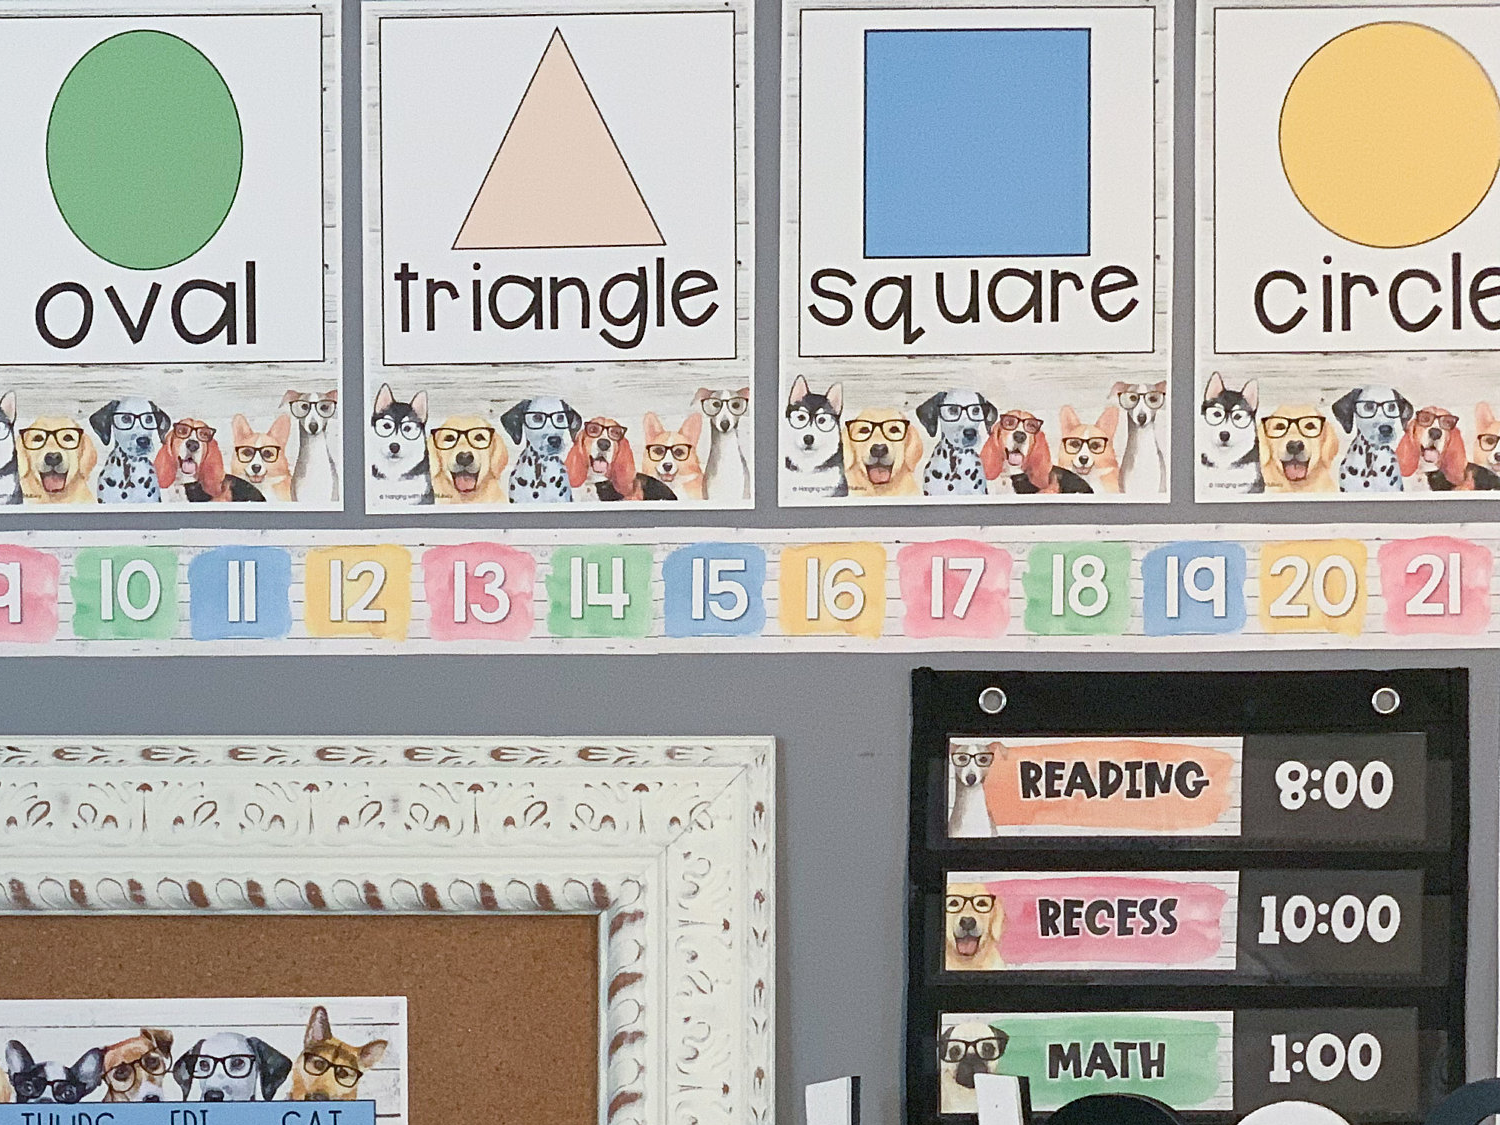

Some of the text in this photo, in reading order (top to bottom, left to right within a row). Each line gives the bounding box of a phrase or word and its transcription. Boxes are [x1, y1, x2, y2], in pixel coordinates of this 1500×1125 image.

[35, 261, 257, 348] oval
[394, 257, 719, 349] triangle
[807, 265, 1140, 345] square
[101, 558, 161, 621] 10
[229, 560, 256, 623] 11
[329, 558, 386, 622] 12
[453, 560, 510, 624] 13
[570, 557, 630, 620] 14
[691, 558, 749, 621] 15
[804, 558, 865, 620] 16
[931, 556, 987, 619] 17
[1051, 553, 1109, 616] 18
[1166, 555, 1226, 618] 19
[1269, 555, 1358, 618] 20
[1405, 553, 1462, 616] 21
[1019, 759, 1394, 811] READING 8:00
[1038, 894, 1401, 945] RECESS 10:00
[1047, 1032, 1382, 1083] MATH 1:00
